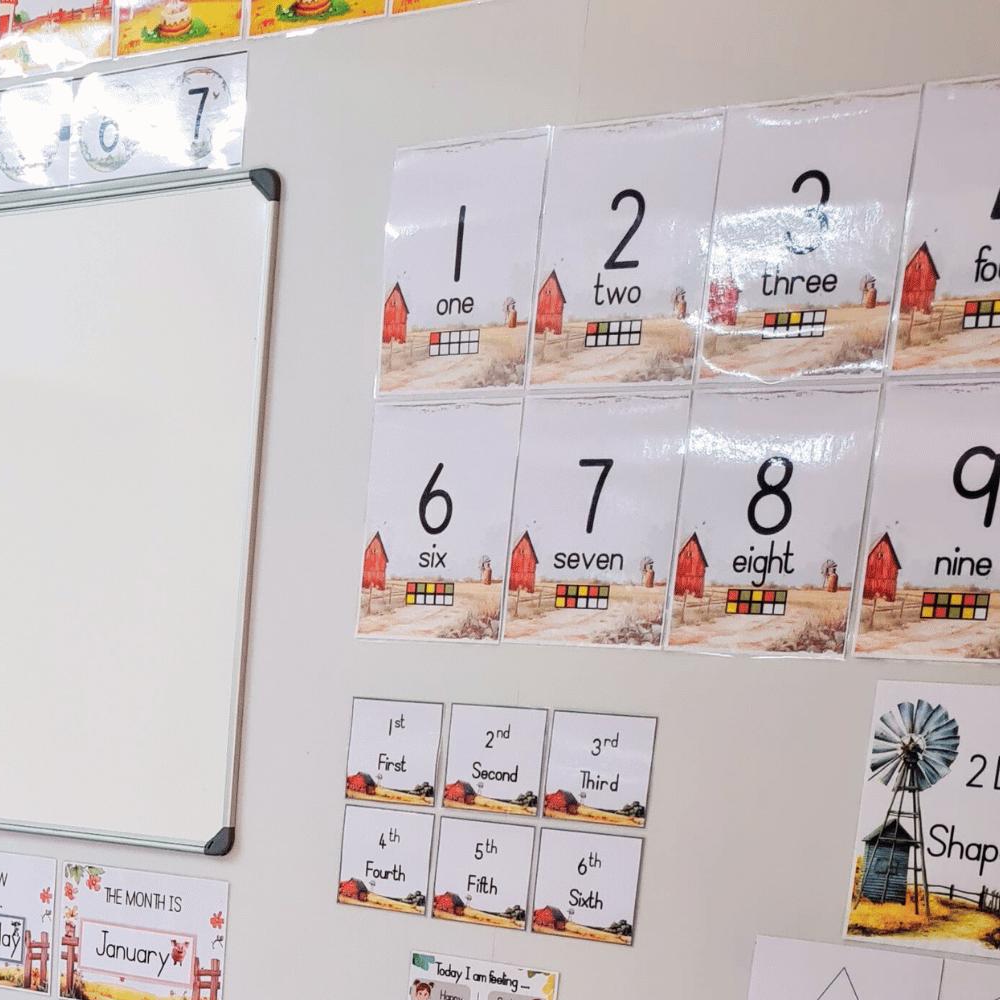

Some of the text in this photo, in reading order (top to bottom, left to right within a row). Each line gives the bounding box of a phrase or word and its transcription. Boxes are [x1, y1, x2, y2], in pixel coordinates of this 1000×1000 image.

[188, 87, 210, 140] 7
[785, 169, 831, 255] 3
[603, 188, 646, 270] 2
[453, 204, 467, 283] 1
[974, 244, 1000, 284] fo
[593, 279, 642, 307] two
[760, 268, 838, 297] three
[435, 295, 475, 316] one
[417, 462, 454, 535] 6
[578, 457, 615, 534] 7
[747, 456, 796, 536] 8
[953, 445, 1000, 528] 9
[418, 544, 448, 569] six
[553, 549, 624, 572] seven
[731, 541, 796, 586] eight
[934, 546, 992, 577] nine
[387, 713, 407, 737] 1st
[484, 723, 511, 749] 2nd
[591, 731, 619, 757] 3rd
[377, 752, 408, 773] First
[472, 761, 519, 783] Second
[580, 770, 620, 793] Third
[378, 826, 401, 850] 4th
[474, 838, 499, 861] 5th
[926, 823, 1000, 877] Shap
[365, 860, 407, 882] Fourth
[577, 851, 603, 876] 6th
[467, 874, 499, 896] Fifth
[104, 886, 183, 913] THE MONTH IS
[568, 888, 604, 911] Sixth
[95, 929, 171, 978] January
[435, 961, 519, 992] Today I am feeling
